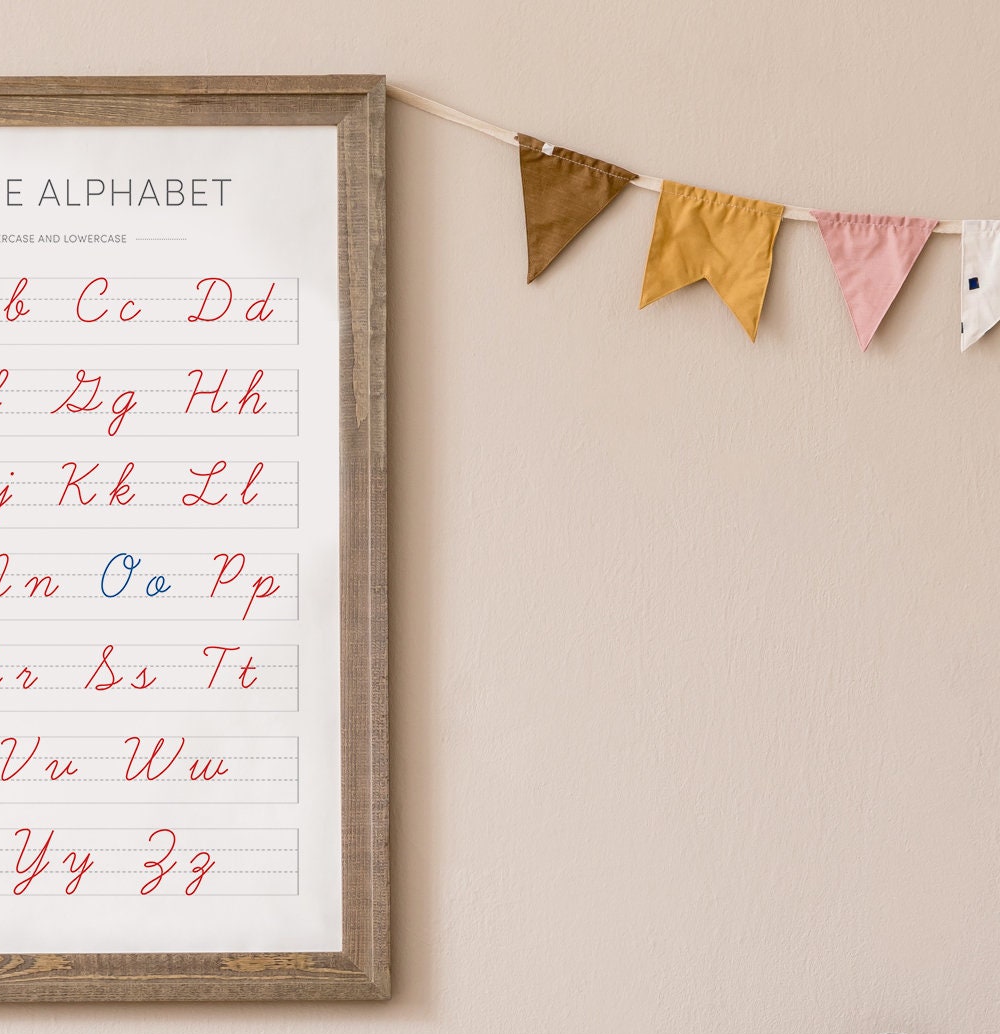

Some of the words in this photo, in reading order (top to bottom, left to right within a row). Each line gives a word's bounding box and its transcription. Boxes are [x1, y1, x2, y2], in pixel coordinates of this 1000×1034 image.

[37, 177, 233, 208] ALPHABET
[37, 233, 61, 245] AND
[63, 233, 128, 245] LOWERCASE
